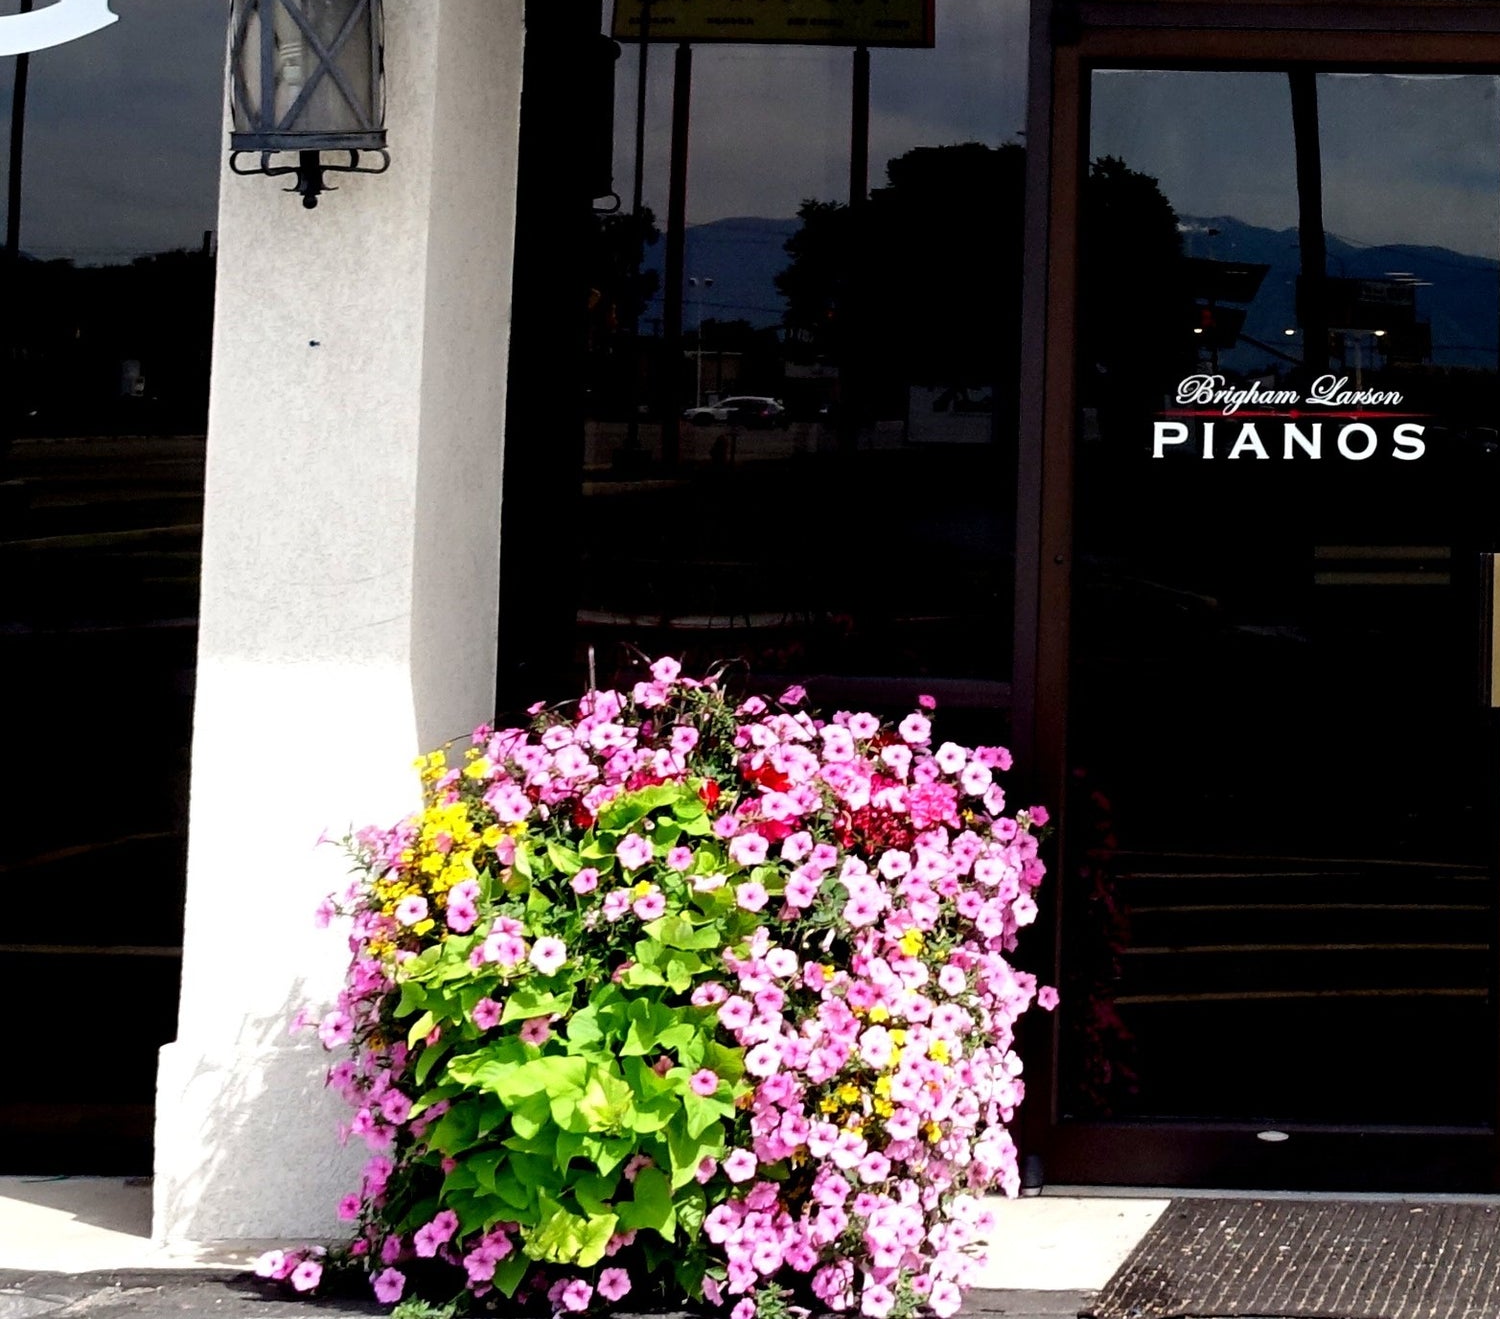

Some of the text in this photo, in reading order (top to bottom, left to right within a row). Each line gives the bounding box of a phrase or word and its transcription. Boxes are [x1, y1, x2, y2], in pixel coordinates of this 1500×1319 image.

[1175, 374, 1403, 416] Brigham Larson
[1152, 421, 1427, 461] PIANOS
